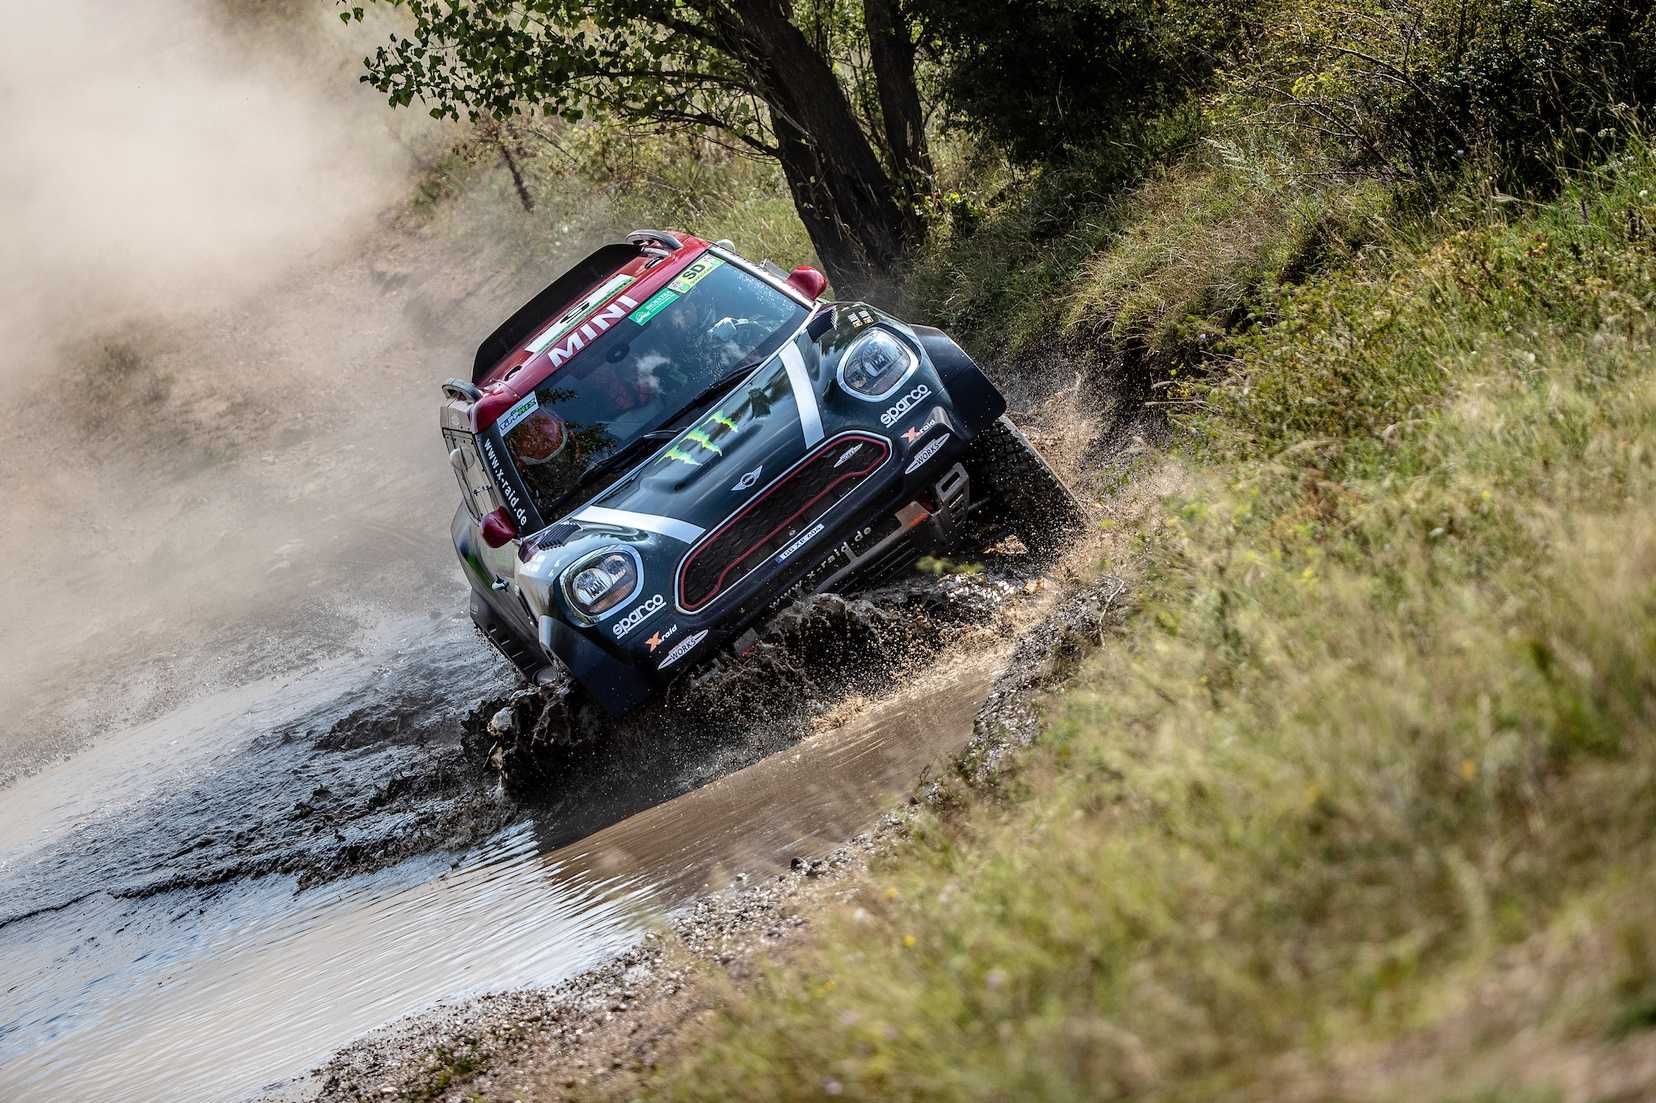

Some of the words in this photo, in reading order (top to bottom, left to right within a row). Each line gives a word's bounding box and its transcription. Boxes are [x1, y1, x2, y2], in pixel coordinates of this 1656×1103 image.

[682, 263, 706, 280] SD
[548, 295, 638, 367] MINI
[880, 384, 929, 429] sparco
[917, 443, 940, 465] WORKS
[484, 438, 527, 526] www.x-raid.de
[612, 594, 664, 640] sparco
[670, 637, 697, 661] WORKS
